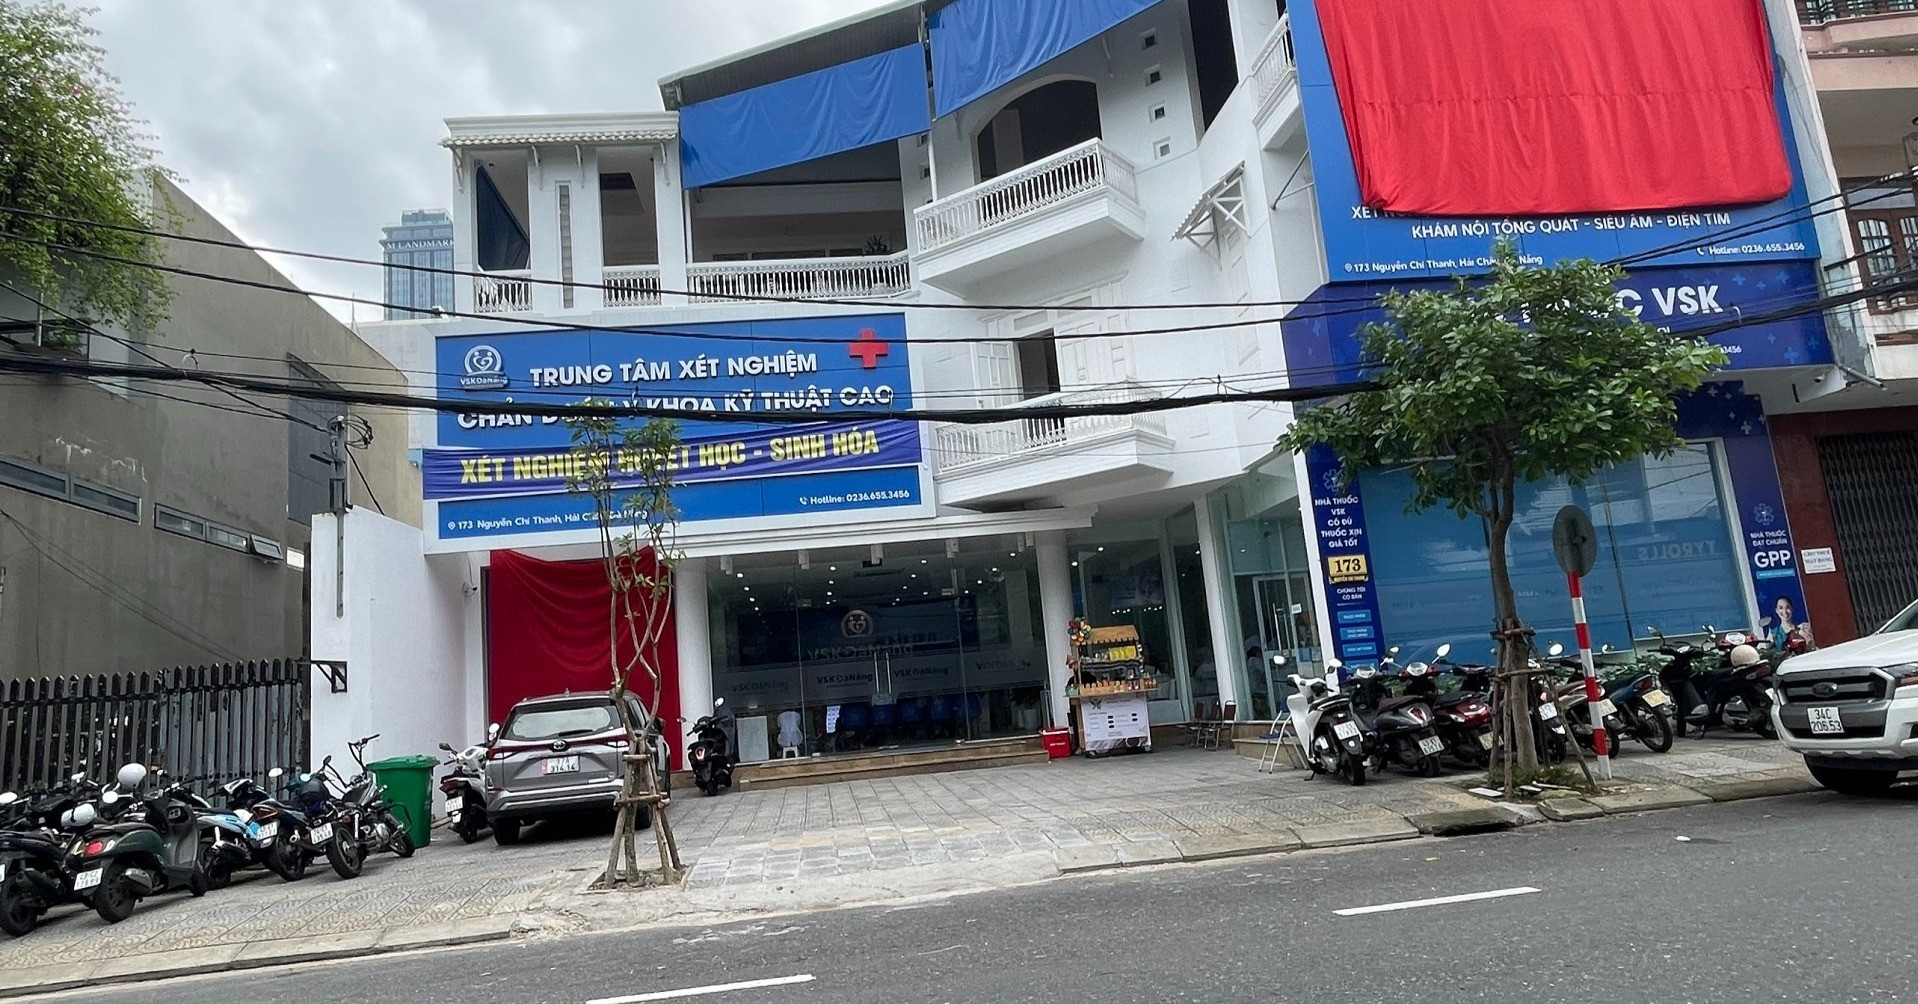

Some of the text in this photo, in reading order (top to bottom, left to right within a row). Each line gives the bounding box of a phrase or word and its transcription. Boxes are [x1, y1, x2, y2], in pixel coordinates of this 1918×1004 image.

[1412, 221, 1458, 239] KHÁM
[1462, 219, 1490, 239] NỘI
[1492, 216, 1536, 235] TỔNG
[1539, 217, 1579, 234] QUÁT
[1594, 213, 1625, 230] SIÊU
[1629, 213, 1653, 229] ÂM
[1666, 211, 1700, 229] ĐIỆN
[1703, 212, 1731, 225] TIM
[1709, 242, 1805, 255] Hotline: 0236.655.3456
[1354, 263, 1370, 272] 173
[1409, 259, 1425, 270] Chí
[1427, 258, 1457, 270] Thanh,
[1652, 285, 1723, 316] VSK
[529, 350, 817, 387] TRUNG TÂM XÉT NGHIỆM
[724, 389, 754, 412] KỸ
[761, 384, 832, 412] THUẬT
[839, 385, 893, 407] CAO
[461, 455, 506, 484] XÉT
[699, 442, 746, 471] HỌC
[769, 434, 827, 462] SINH
[833, 427, 880, 456] HÓA
[810, 489, 910, 505] Hotline: 0236.655.3456
[1315, 495, 1358, 506] NHÀ THUỐC
[457, 521, 474, 530] 173
[477, 517, 512, 531] Nguyễn
[515, 515, 531, 526] Chí
[1327, 518, 1340, 526] CÓ
[1321, 527, 1347, 537] THUỐC
[1329, 537, 1358, 548] GIÁ TỐT
[1335, 558, 1361, 573] 173
[1754, 550, 1791, 568] GPP
[1814, 708, 1832, 720] 34C
